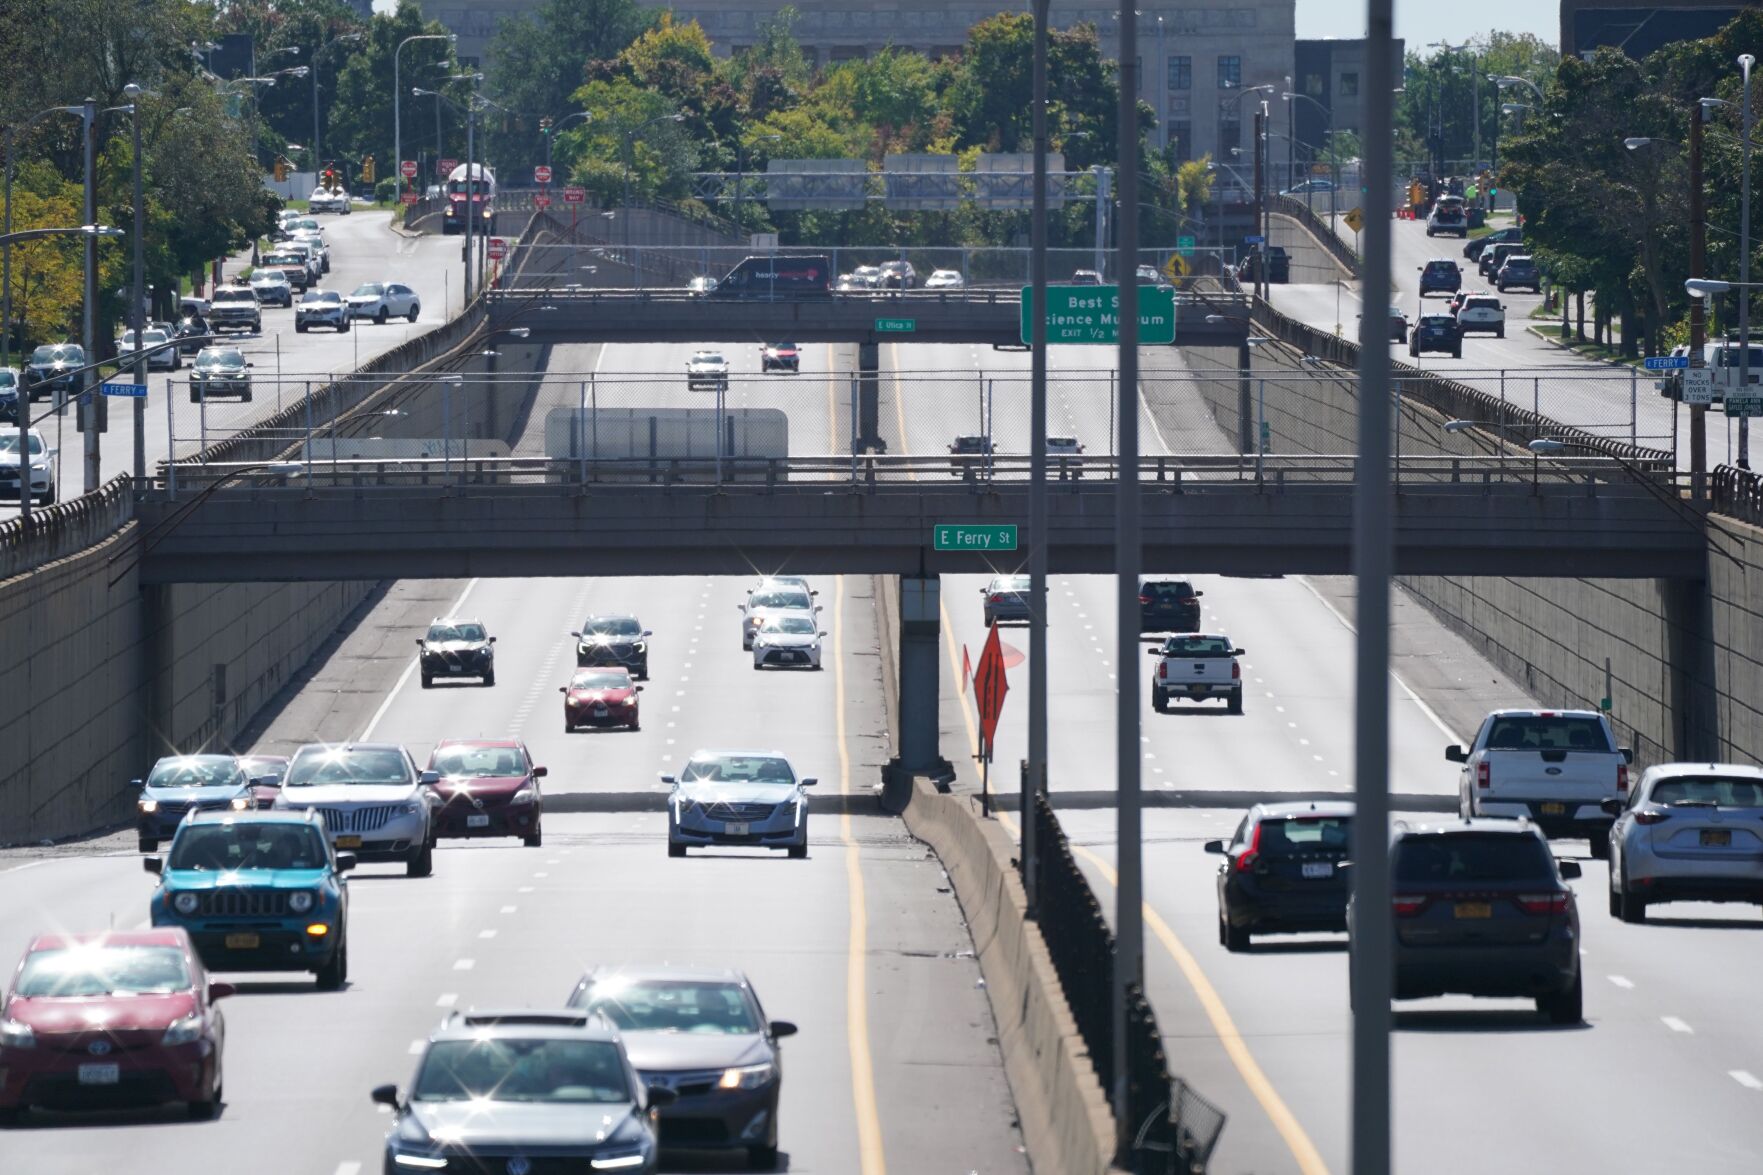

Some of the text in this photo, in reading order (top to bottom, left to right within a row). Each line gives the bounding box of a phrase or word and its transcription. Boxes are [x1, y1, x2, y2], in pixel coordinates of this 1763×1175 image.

[1068, 296, 1103, 308] Best
[1045, 313, 1164, 325] cience Muum
[1061, 329, 1082, 337] EXIT
[1653, 358, 1679, 368] FERRY
[110, 385, 137, 395] FERRY
[941, 530, 1010, 548] E Ferry St
